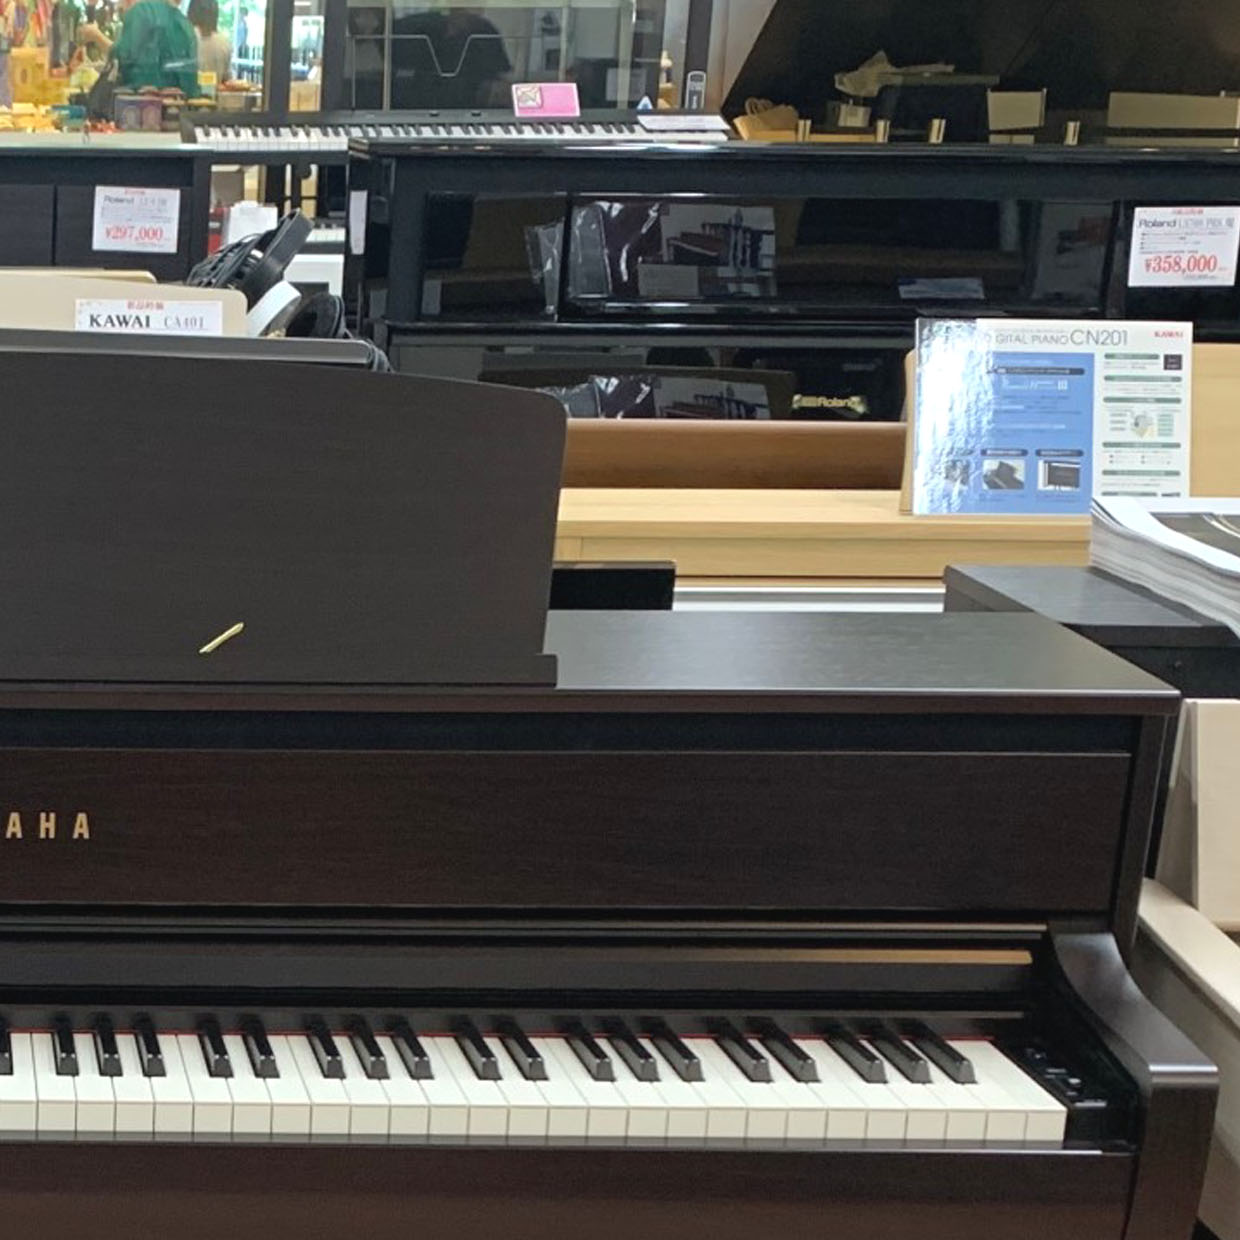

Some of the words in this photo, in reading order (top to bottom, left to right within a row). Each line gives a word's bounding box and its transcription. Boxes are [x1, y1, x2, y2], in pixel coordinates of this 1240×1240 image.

[1138, 218, 1177, 227] Roland
[105, 224, 164, 241] ¥297,000
[1144, 254, 1218, 274] ¥358,000
[89, 314, 151, 328] KAWAI
[163, 316, 205, 329] CA401
[1031, 334, 1069, 346] PIANO
[1069, 329, 1129, 346] CN201
